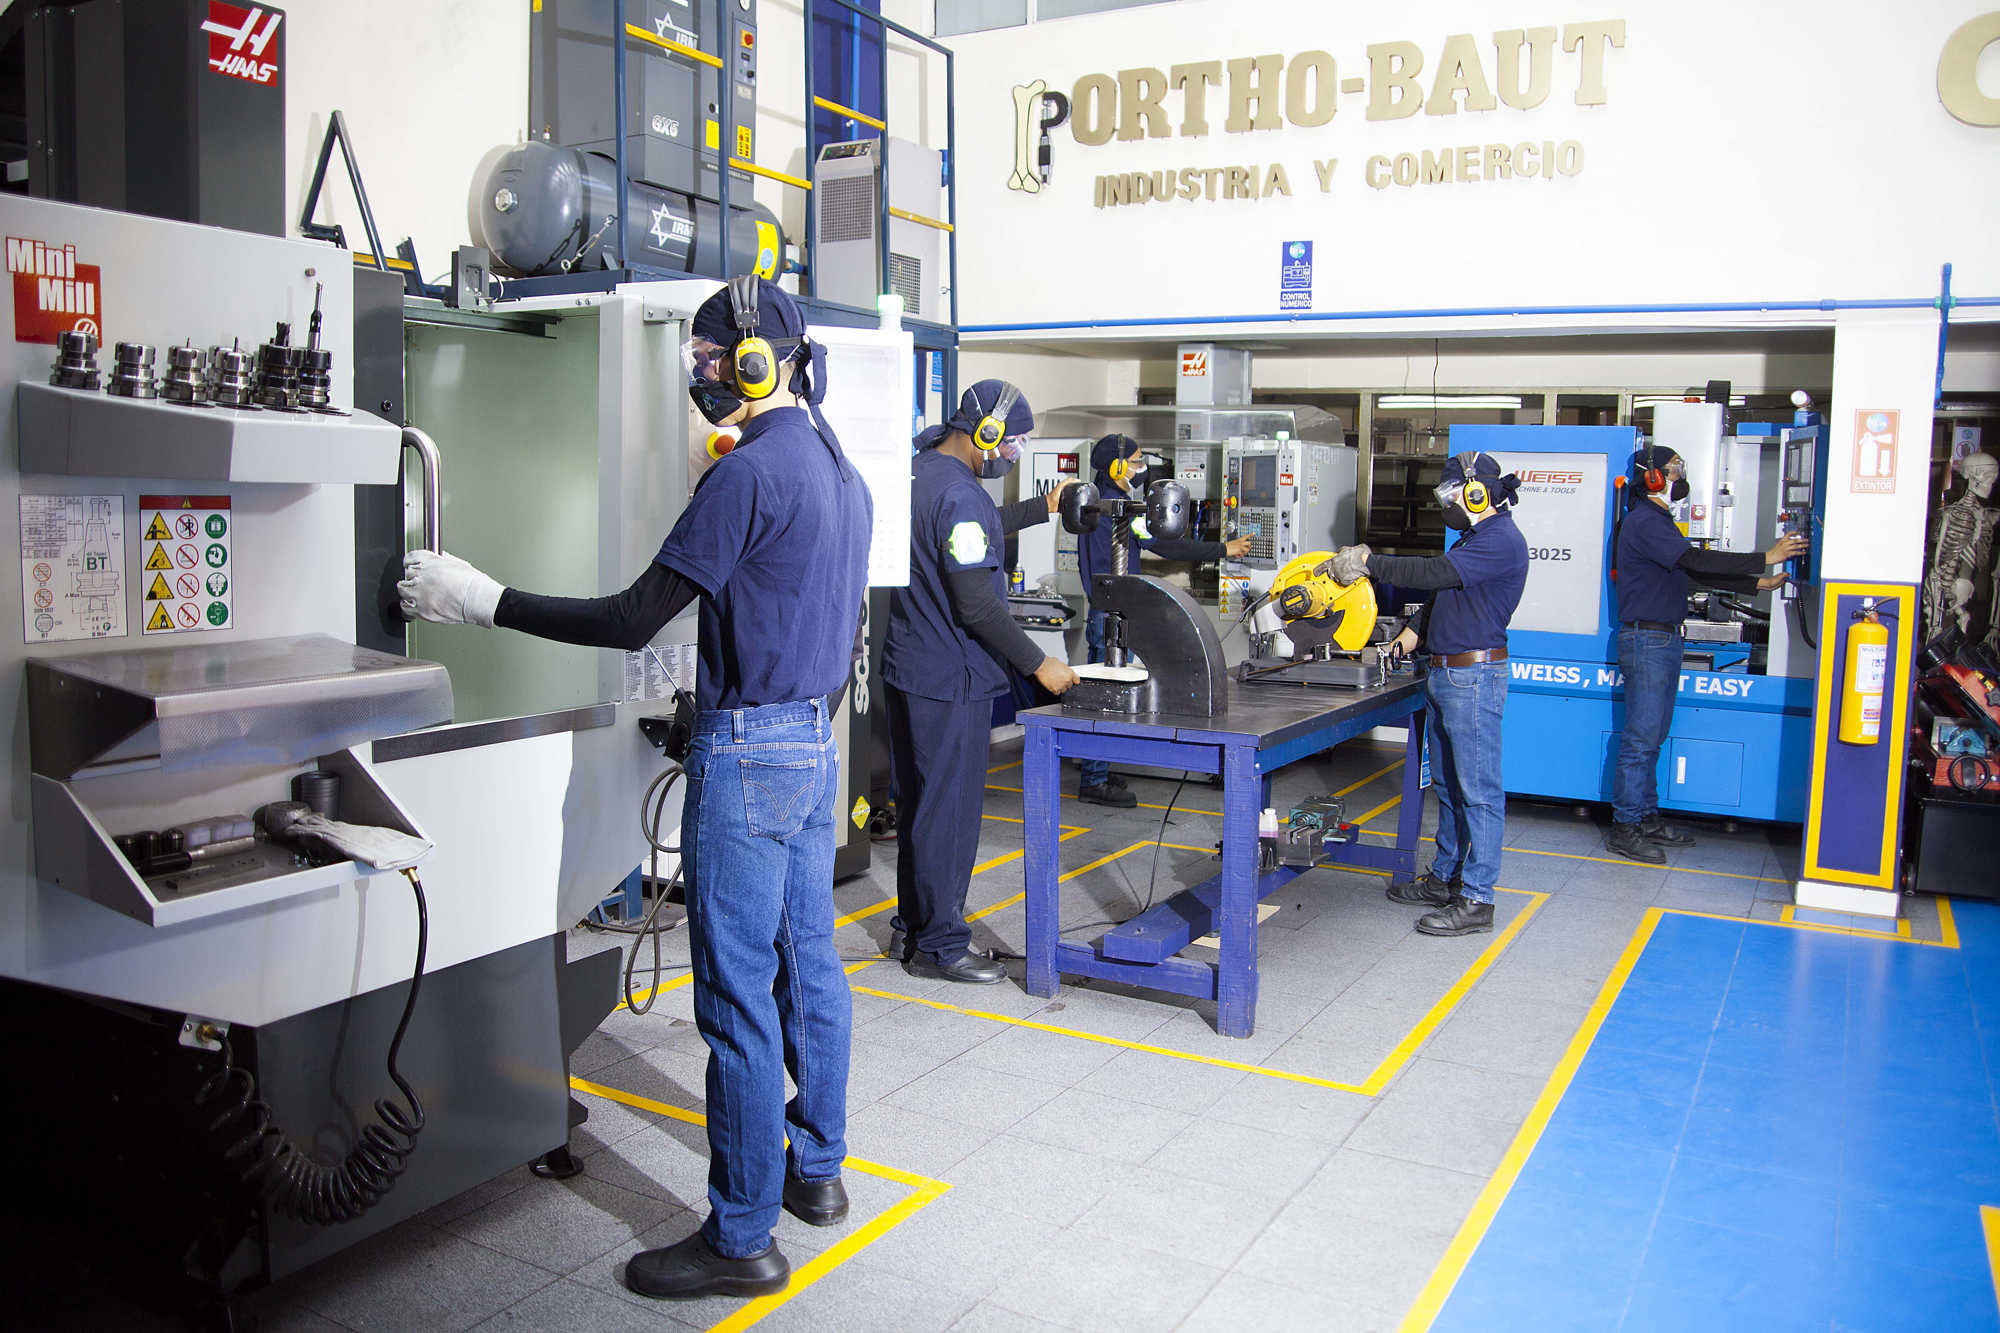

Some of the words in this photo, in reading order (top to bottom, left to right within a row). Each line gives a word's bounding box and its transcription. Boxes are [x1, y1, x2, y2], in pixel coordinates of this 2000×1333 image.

[676, 32, 698, 50] IRM
[209, 54, 278, 82] HAAS
[1094, 163, 1292, 209] INDUSTRIA
[1313, 158, 1338, 193] Y
[1365, 139, 1585, 190] COMERCIO
[671, 220, 694, 237] IRM
[6, 236, 76, 279] Mini
[38, 278, 95, 315] Mill
[1060, 458, 1077, 469] Mini
[1514, 470, 1584, 484] WEISS
[87, 556, 108, 570] BT
[1529, 548, 1571, 561] 3025
[1695, 677, 1754, 697] EASY
